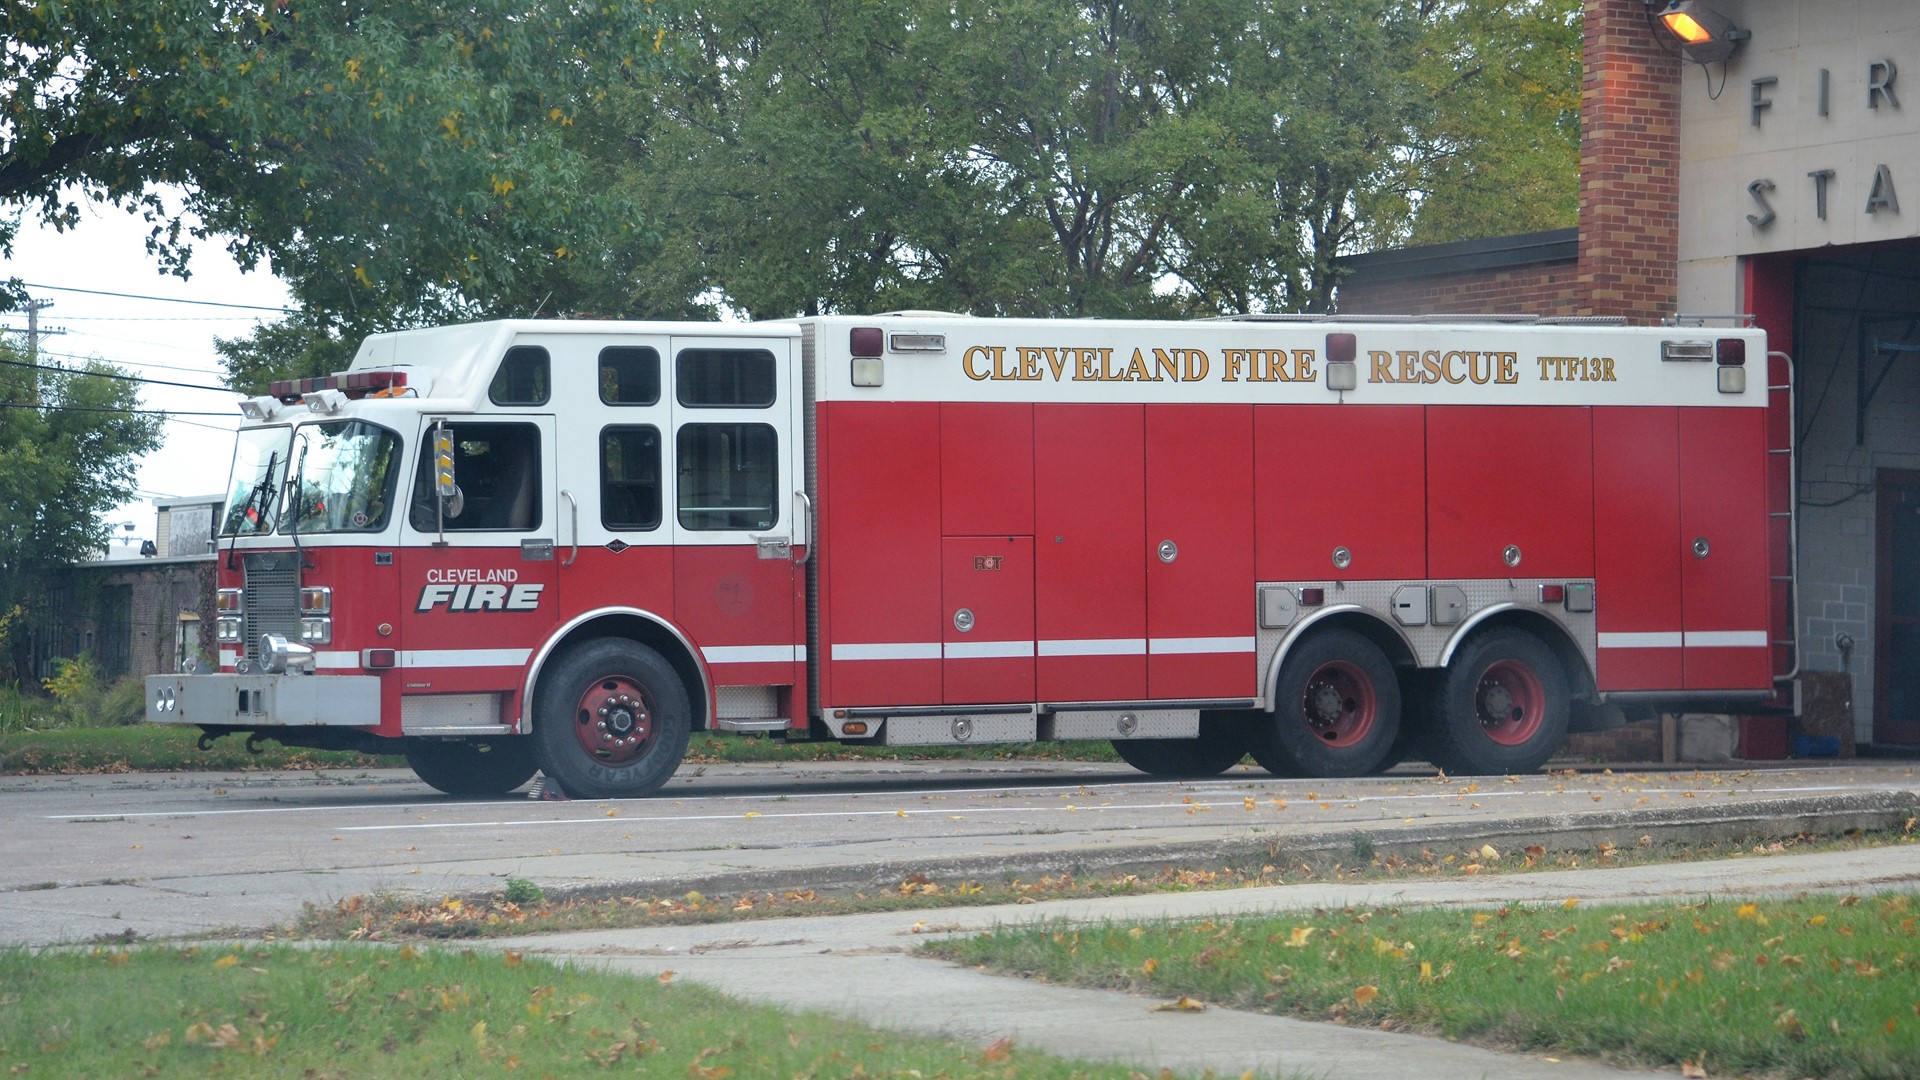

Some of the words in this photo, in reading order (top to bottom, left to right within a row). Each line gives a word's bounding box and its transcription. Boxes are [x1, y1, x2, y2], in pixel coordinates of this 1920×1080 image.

[1750, 58, 1901, 129] FIR
[1746, 163, 1900, 229] STA
[962, 345, 1210, 382] CLEVELAND
[1221, 348, 1317, 383] FIRE
[1367, 350, 1520, 385] RESCUE
[1537, 356, 1617, 382] TTF13R
[427, 569, 519, 583] CLEVELAND
[414, 583, 545, 613] FIRE
